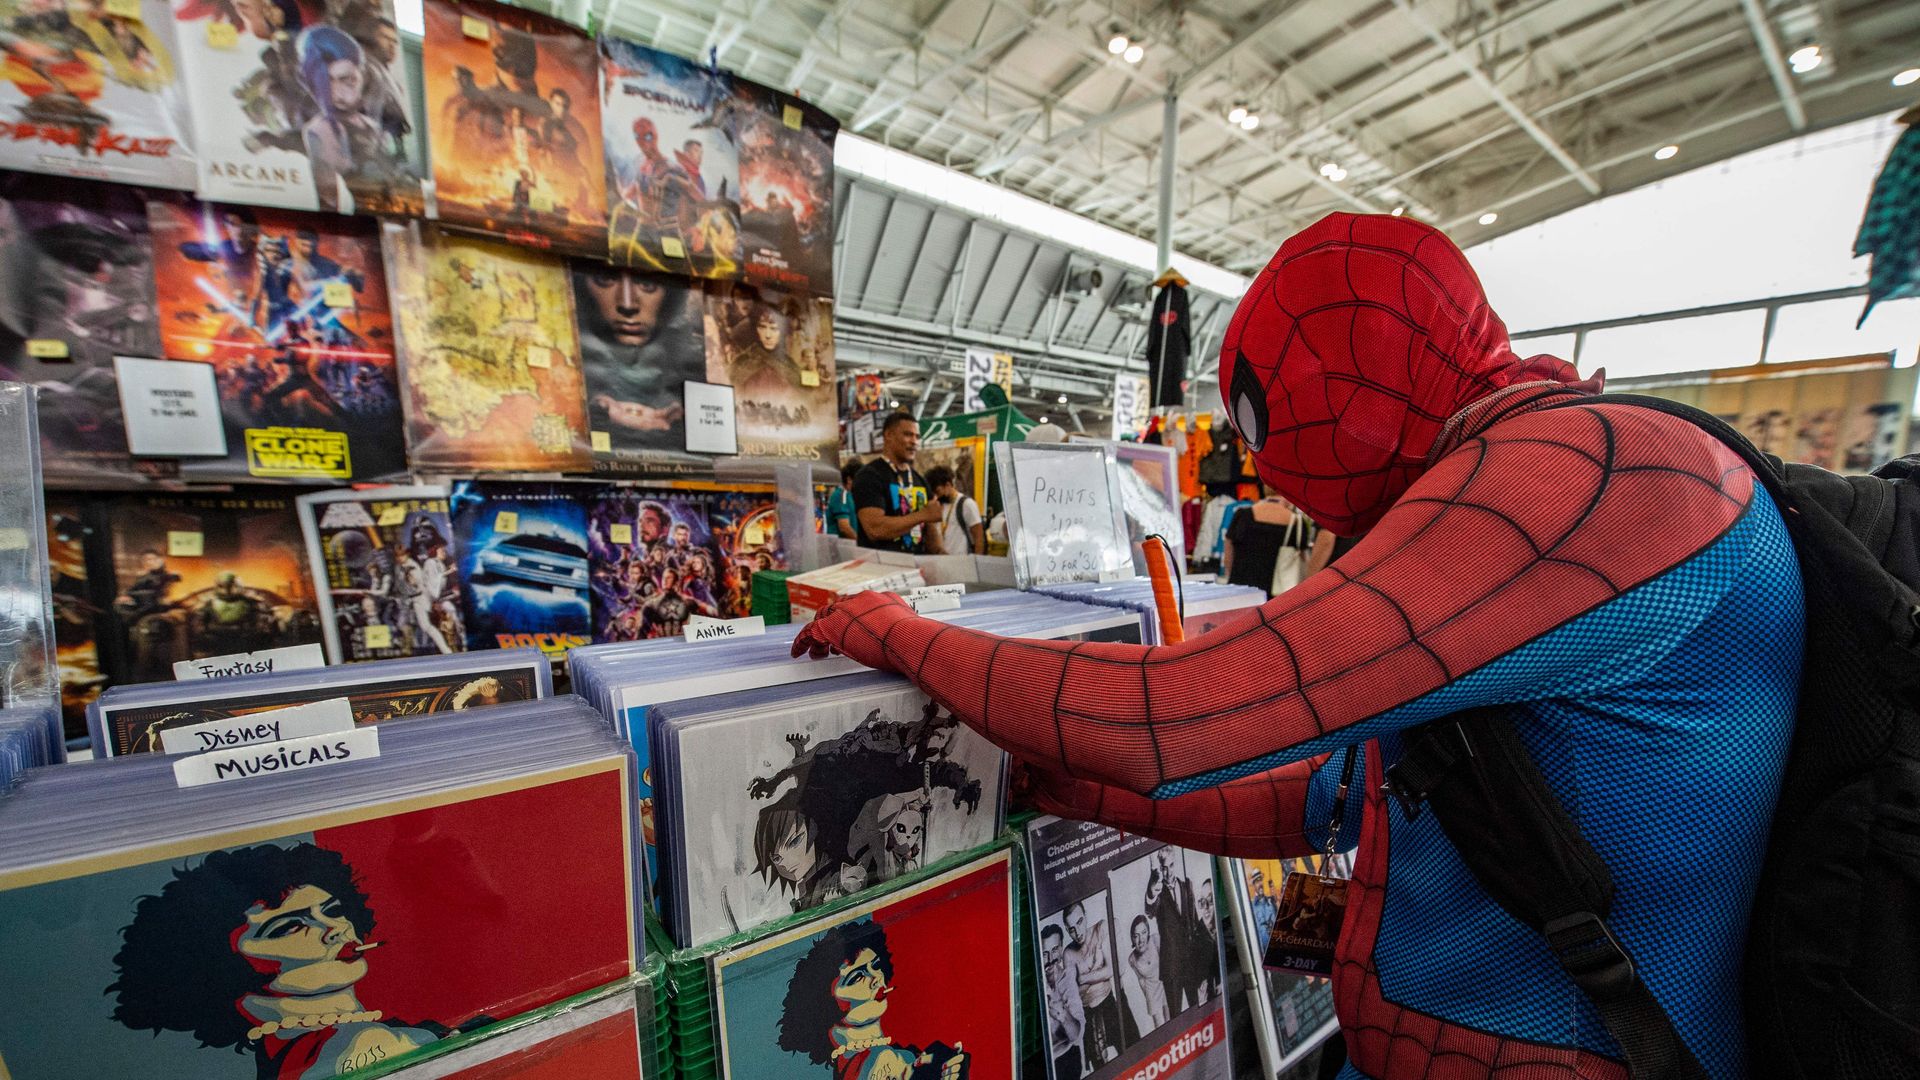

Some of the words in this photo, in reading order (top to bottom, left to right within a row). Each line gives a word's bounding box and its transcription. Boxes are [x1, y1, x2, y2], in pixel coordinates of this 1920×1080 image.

[211, 162, 302, 185] ARCANE
[253, 438, 344, 455] CLONE
[256, 453, 343, 469] WARS
[1033, 476, 1096, 506] PRINTS
[1047, 556, 1056, 572] 3
[1062, 559, 1077, 571] FOR
[695, 624, 736, 640] ANIME
[198, 658, 273, 678] Fantasy
[195, 720, 280, 752] Disney
[214, 741, 351, 780] MUSICALS
[1043, 856, 1066, 871] leisure
[1067, 850, 1082, 862] wear
[1082, 844, 1094, 855] and
[1094, 833, 1121, 849] matching
[1047, 838, 1080, 858] Choose
[1086, 829, 1105, 842] starter
[1055, 870, 1067, 882] But
[1067, 863, 1080, 878] why
[1081, 856, 1100, 870] would
[1099, 847, 1120, 863] anyone
[1120, 842, 1134, 853] want
[1134, 838, 1141, 846] to
[1282, 956, 1318, 970] 3-DAY
[1127, 1022, 1215, 1080] spotting
